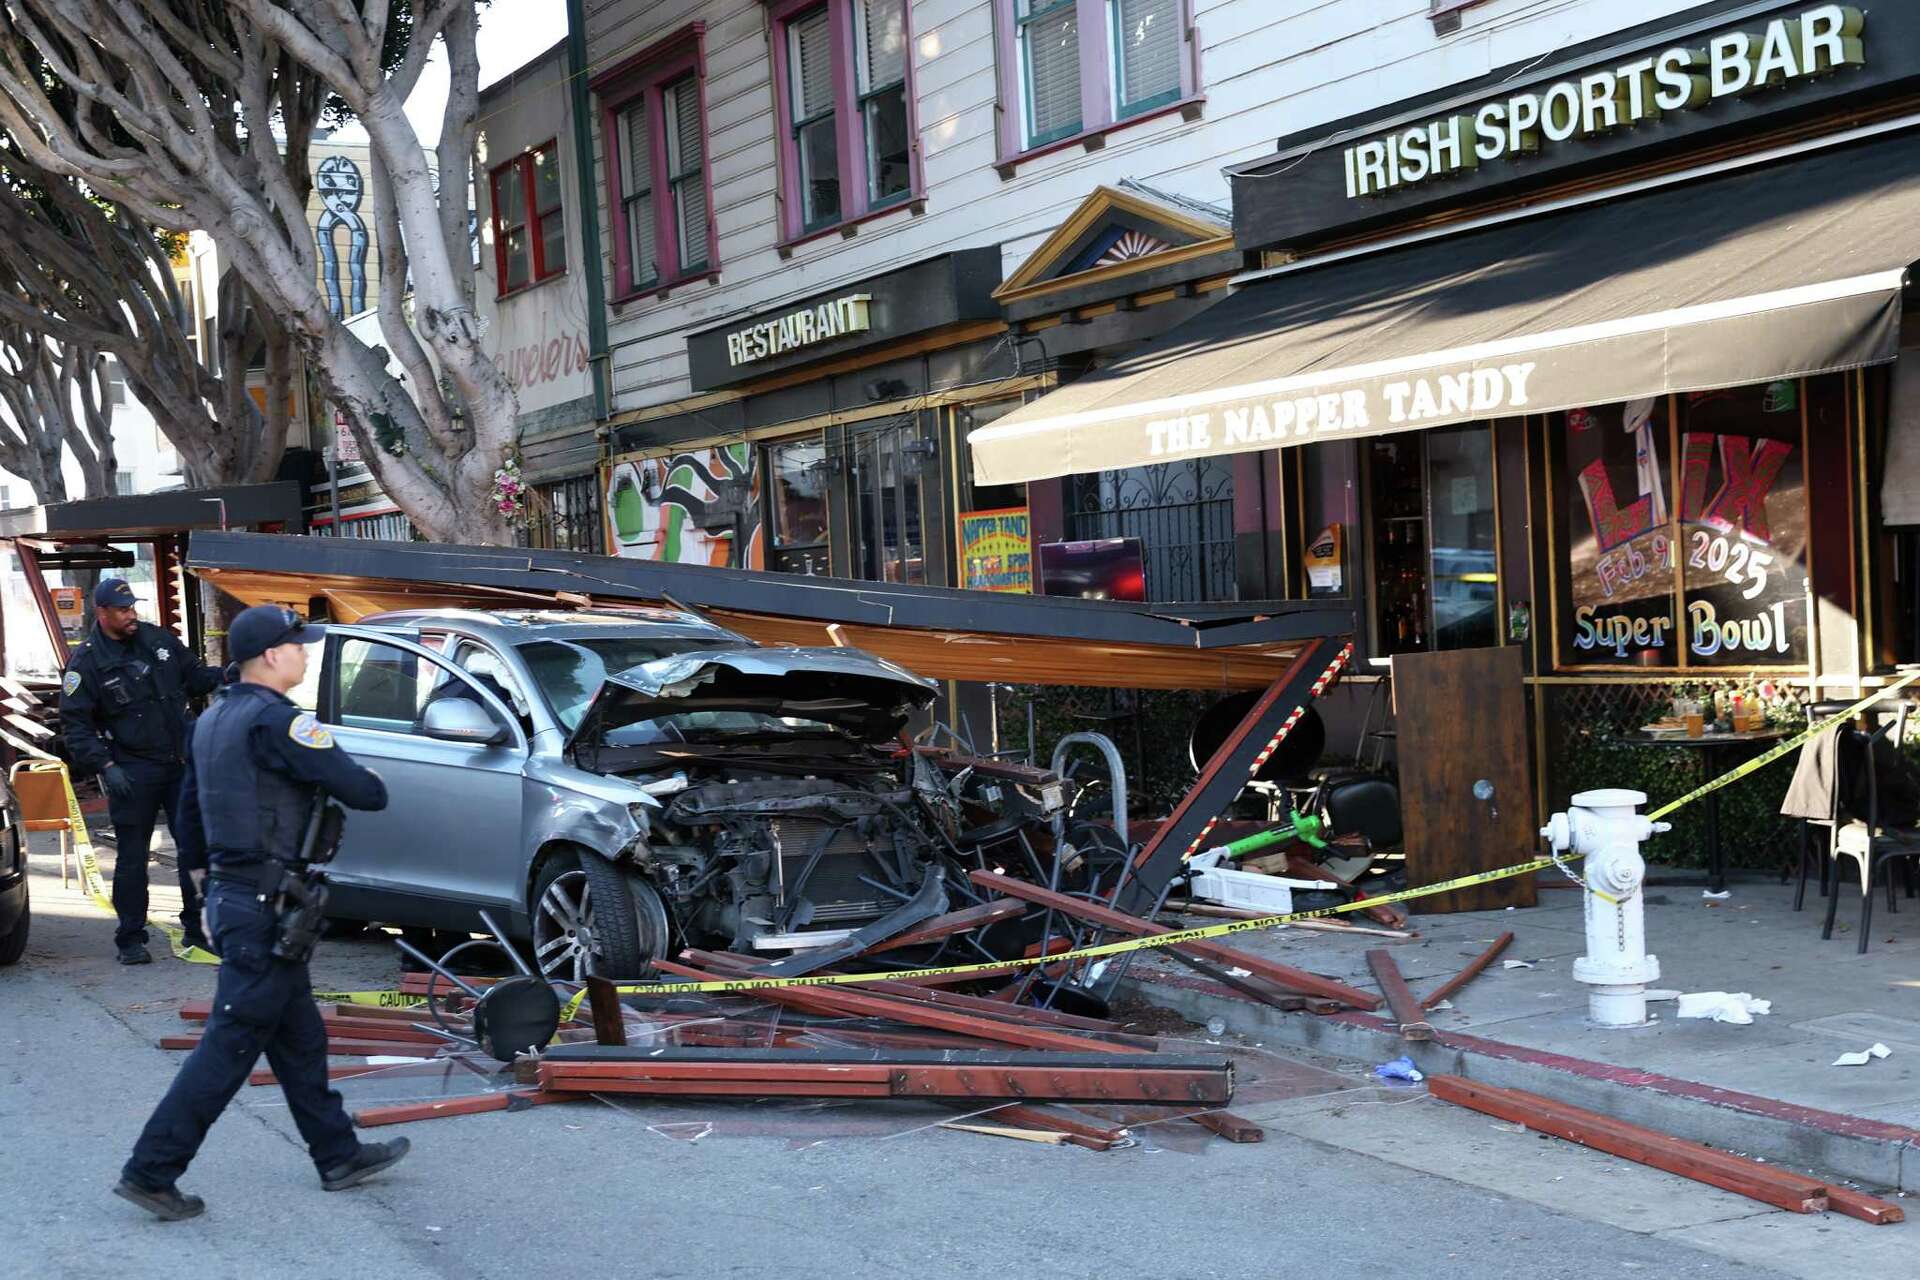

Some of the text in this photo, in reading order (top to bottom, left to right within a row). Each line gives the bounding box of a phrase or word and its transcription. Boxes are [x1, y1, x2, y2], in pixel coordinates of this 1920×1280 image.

[1344, 4, 1848, 199] IRISH SPORTS BAR
[727, 294, 871, 366] RESTAURANT
[1146, 362, 1536, 456] THE NAPPER TANDY
[1596, 542, 1651, 597] Feb.
[1689, 531, 1774, 600] 2025
[1574, 600, 1790, 658] Super Bowl
